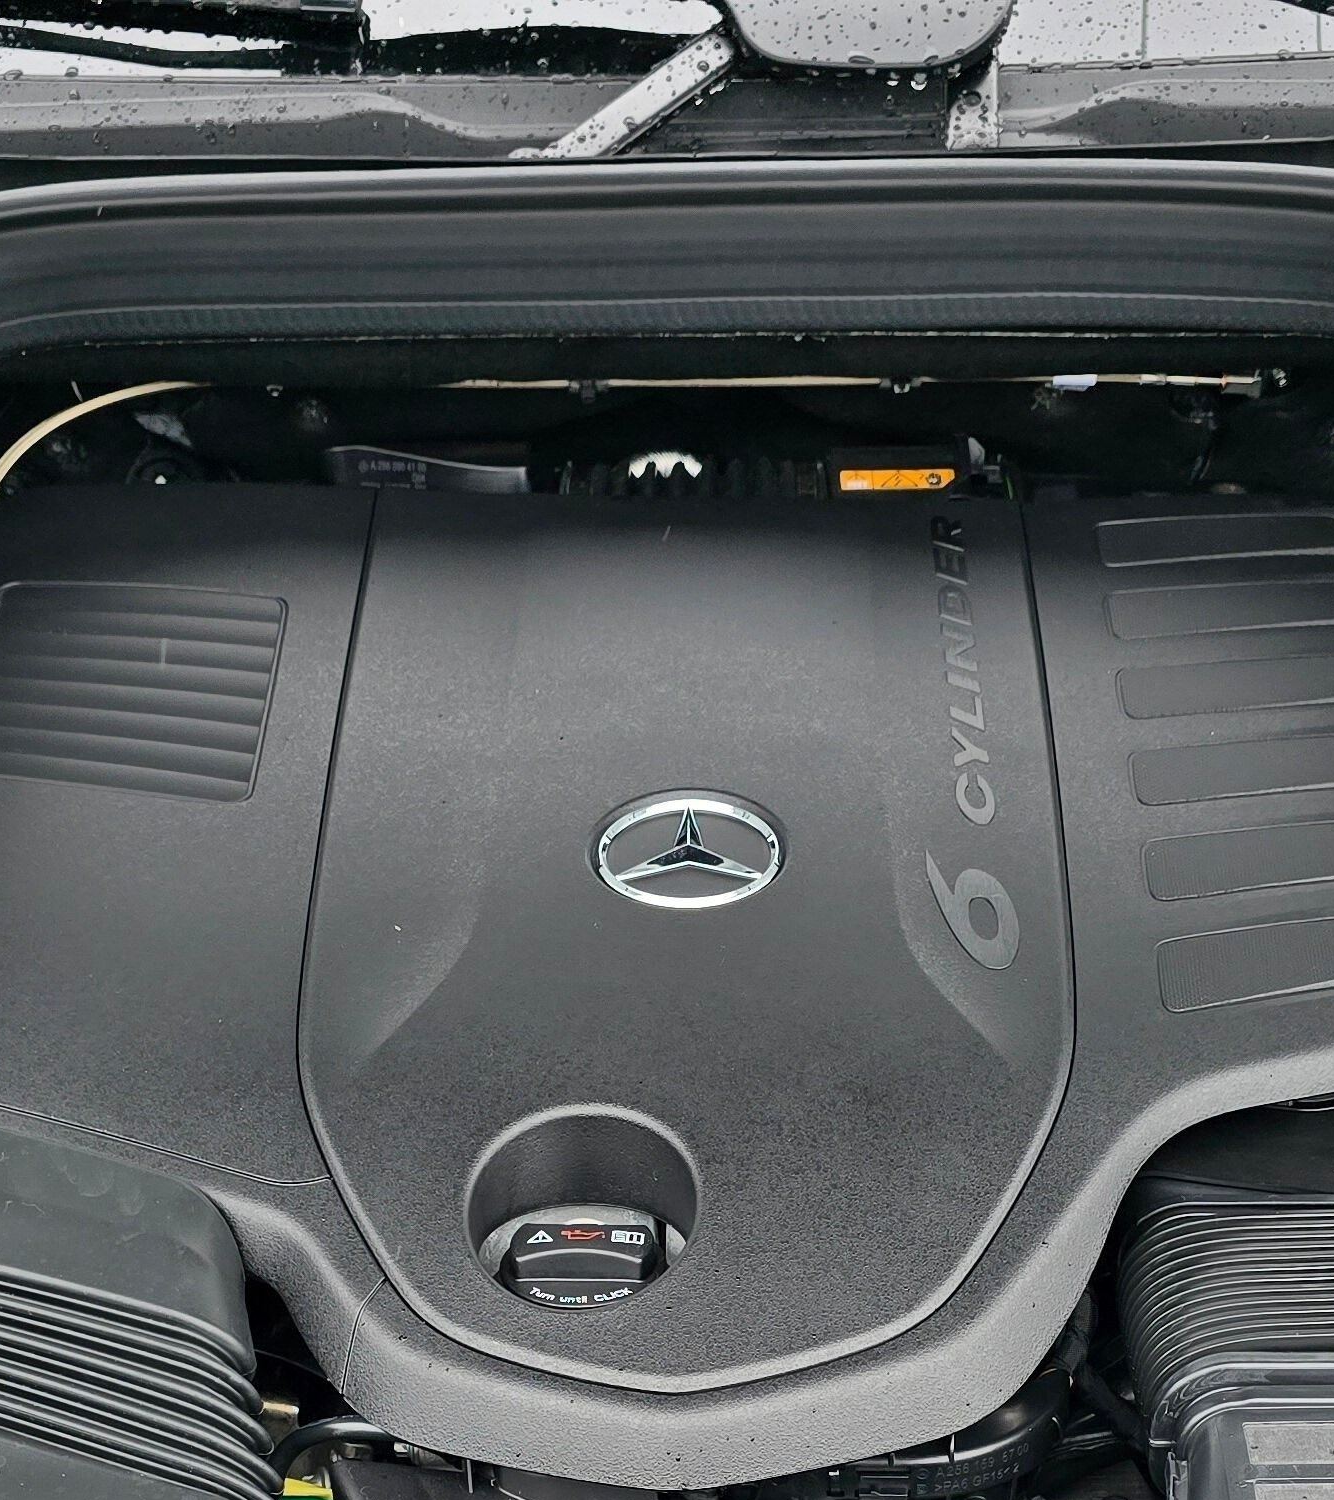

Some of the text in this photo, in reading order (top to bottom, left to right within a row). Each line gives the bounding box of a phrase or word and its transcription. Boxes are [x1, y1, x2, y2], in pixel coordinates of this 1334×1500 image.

[924, 513, 1020, 971] 6 CYLINDER
[593, 1286, 634, 1303] CLICK
